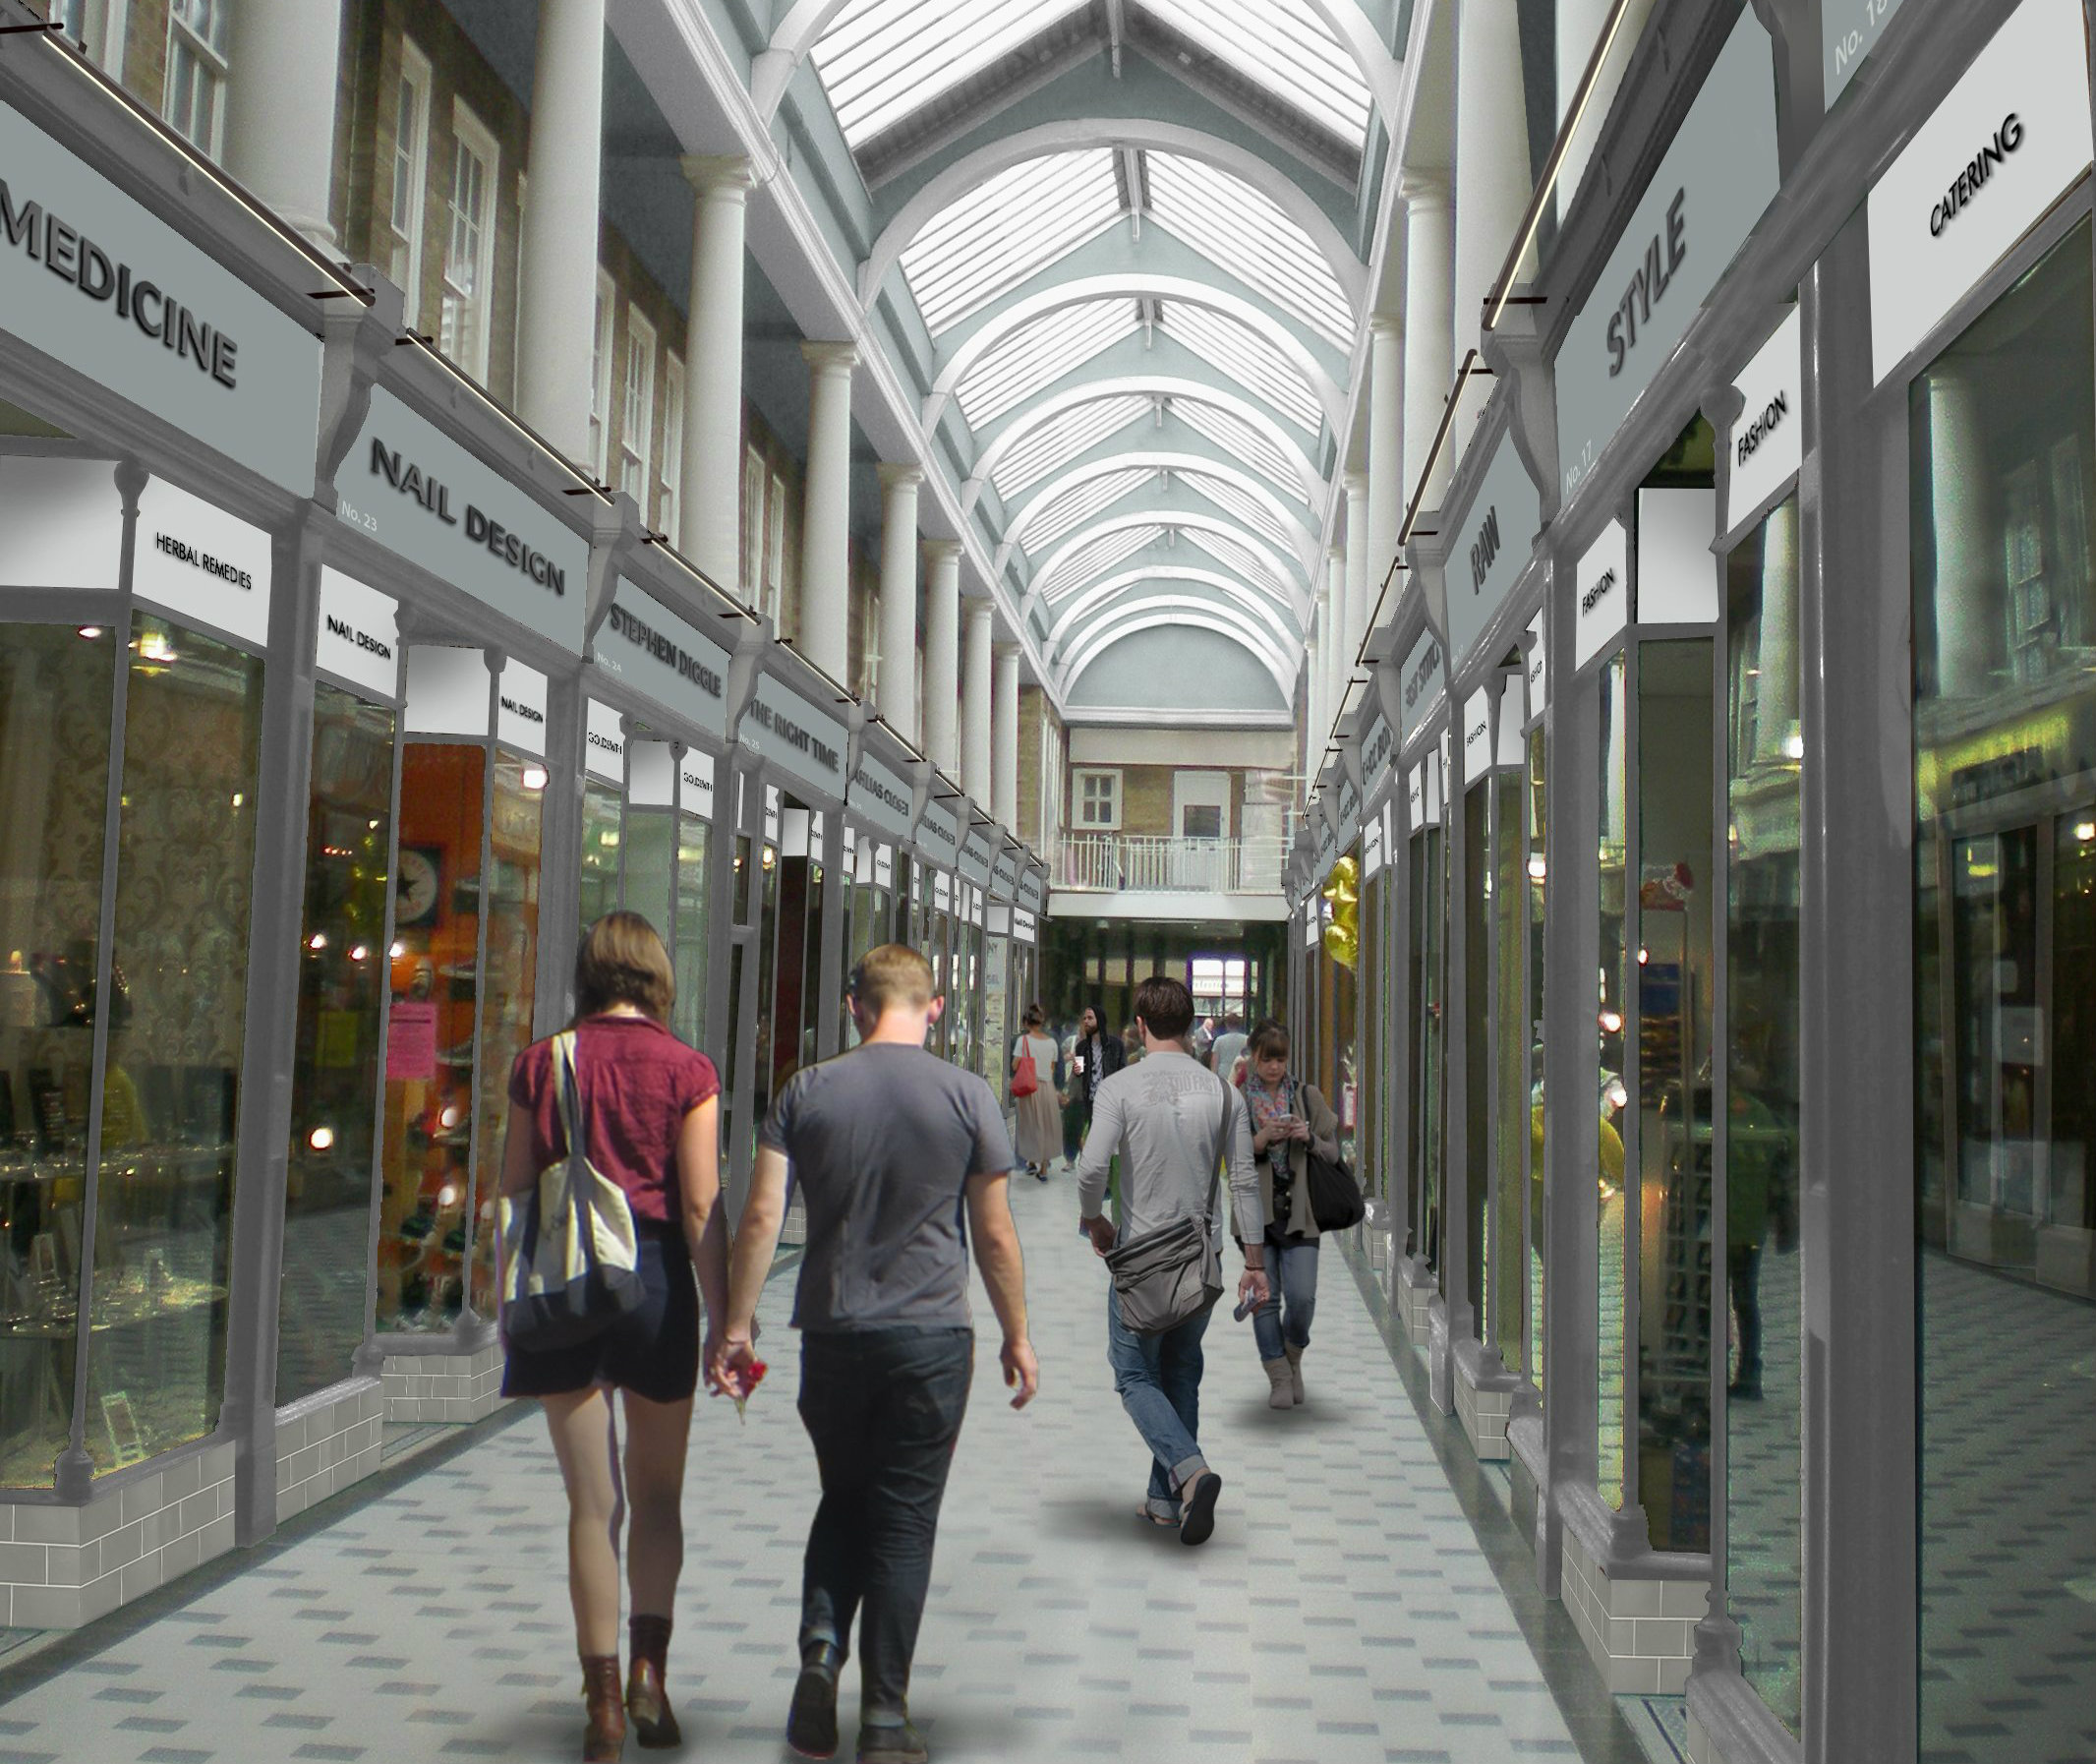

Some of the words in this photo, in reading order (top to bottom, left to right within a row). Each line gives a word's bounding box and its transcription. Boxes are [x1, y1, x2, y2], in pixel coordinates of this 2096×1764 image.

[1931, 113, 2023, 237] CATERING
[0, 177, 238, 390] MEDICINE
[1605, 186, 1687, 379] STYLE
[1581, 440, 1592, 467] 17
[1737, 389, 1786, 468] FASHION
[341, 500, 361, 524] No.
[363, 512, 378, 532] 23
[370, 437, 457, 526] NAIL
[466, 503, 565, 597] DESIGN
[1470, 505, 1500, 596] RAW
[156, 532, 200, 567] HERBAL
[203, 554, 252, 591] REMEDIES
[1582, 567, 1614, 618] FASHION
[327, 614, 356, 642] NAIL
[356, 630, 391, 660] DESIGN
[611, 603, 677, 669] STEPHEN
[678, 649, 723, 700] DIGGLE
[501, 695, 518, 714] NAIL
[519, 703, 544, 724] DESIGN
[774, 712, 810, 753] RIGHT
[811, 737, 841, 774] TIME
